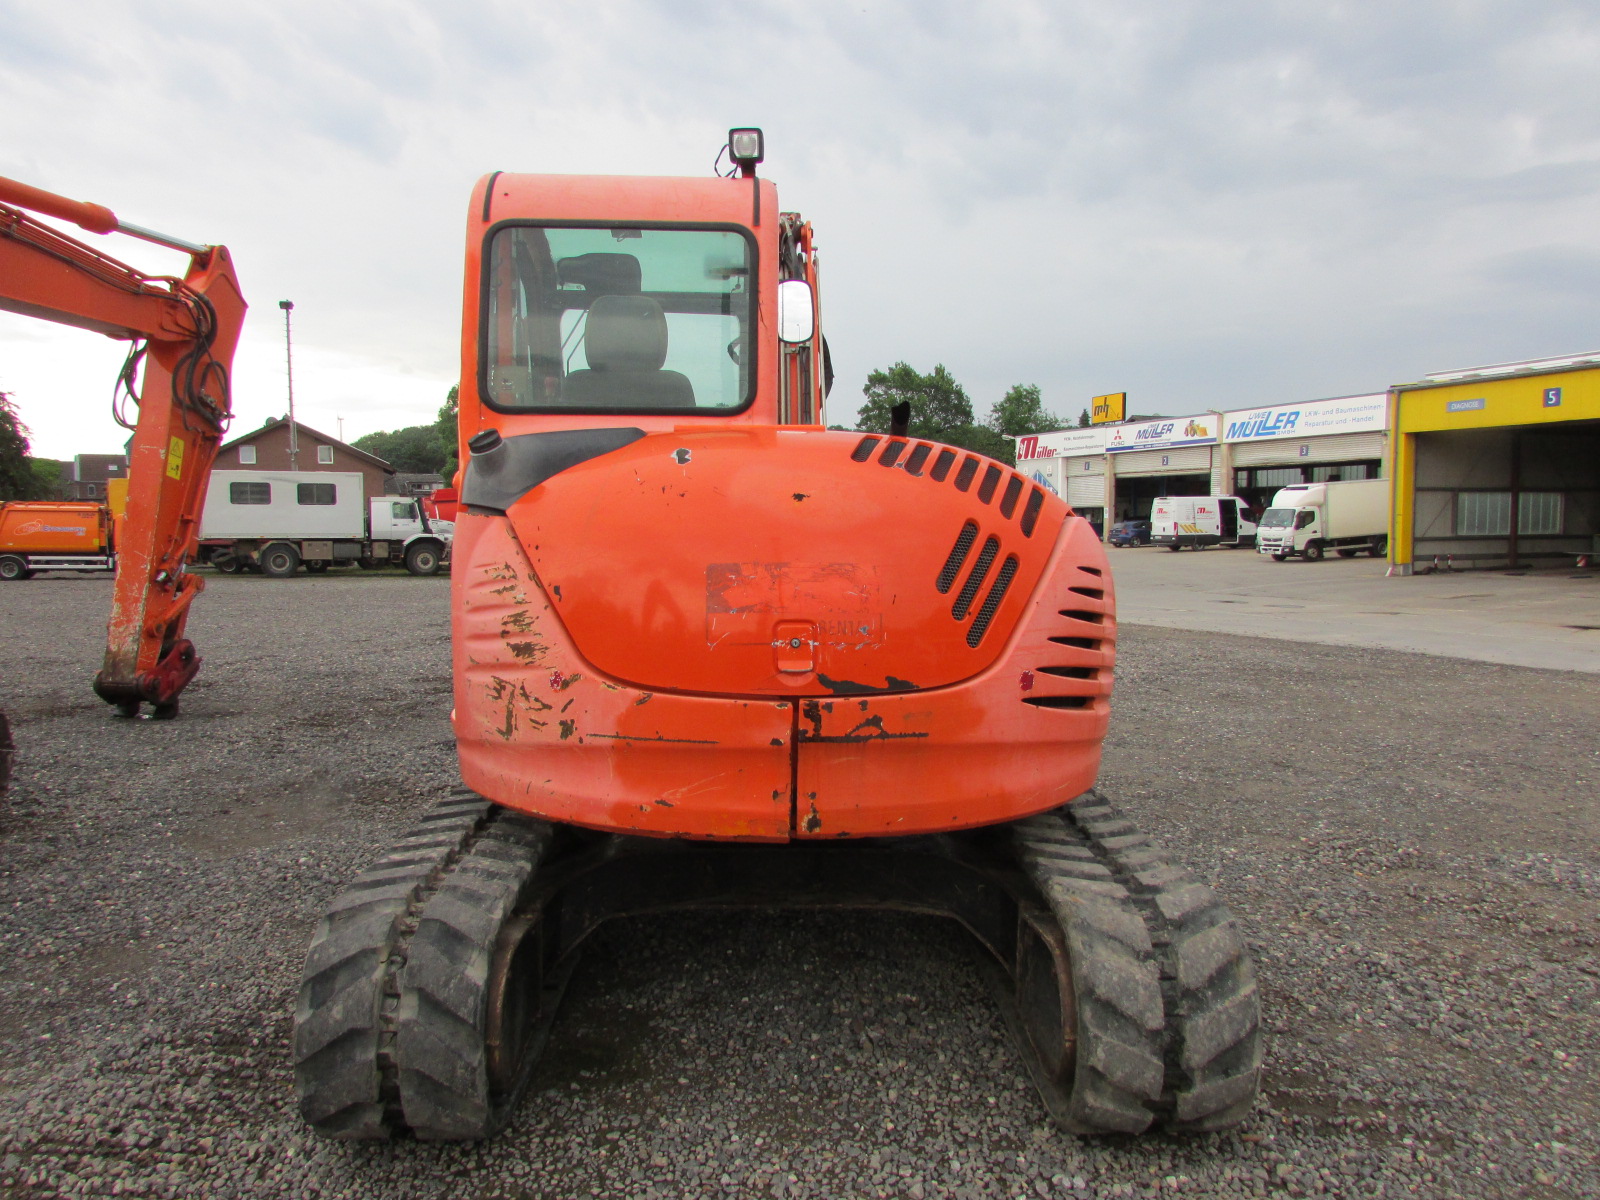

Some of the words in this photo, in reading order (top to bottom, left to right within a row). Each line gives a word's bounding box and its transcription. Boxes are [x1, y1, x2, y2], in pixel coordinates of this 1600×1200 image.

[1547, 391, 1556, 404] 5
[1335, 404, 1384, 415] Baumaschinen-
[1451, 401, 1479, 410] DIAGNOSE
[1248, 411, 1267, 420] UWE
[1304, 419, 1334, 428] Reparatur
[1017, 436, 1057, 460] Müller
